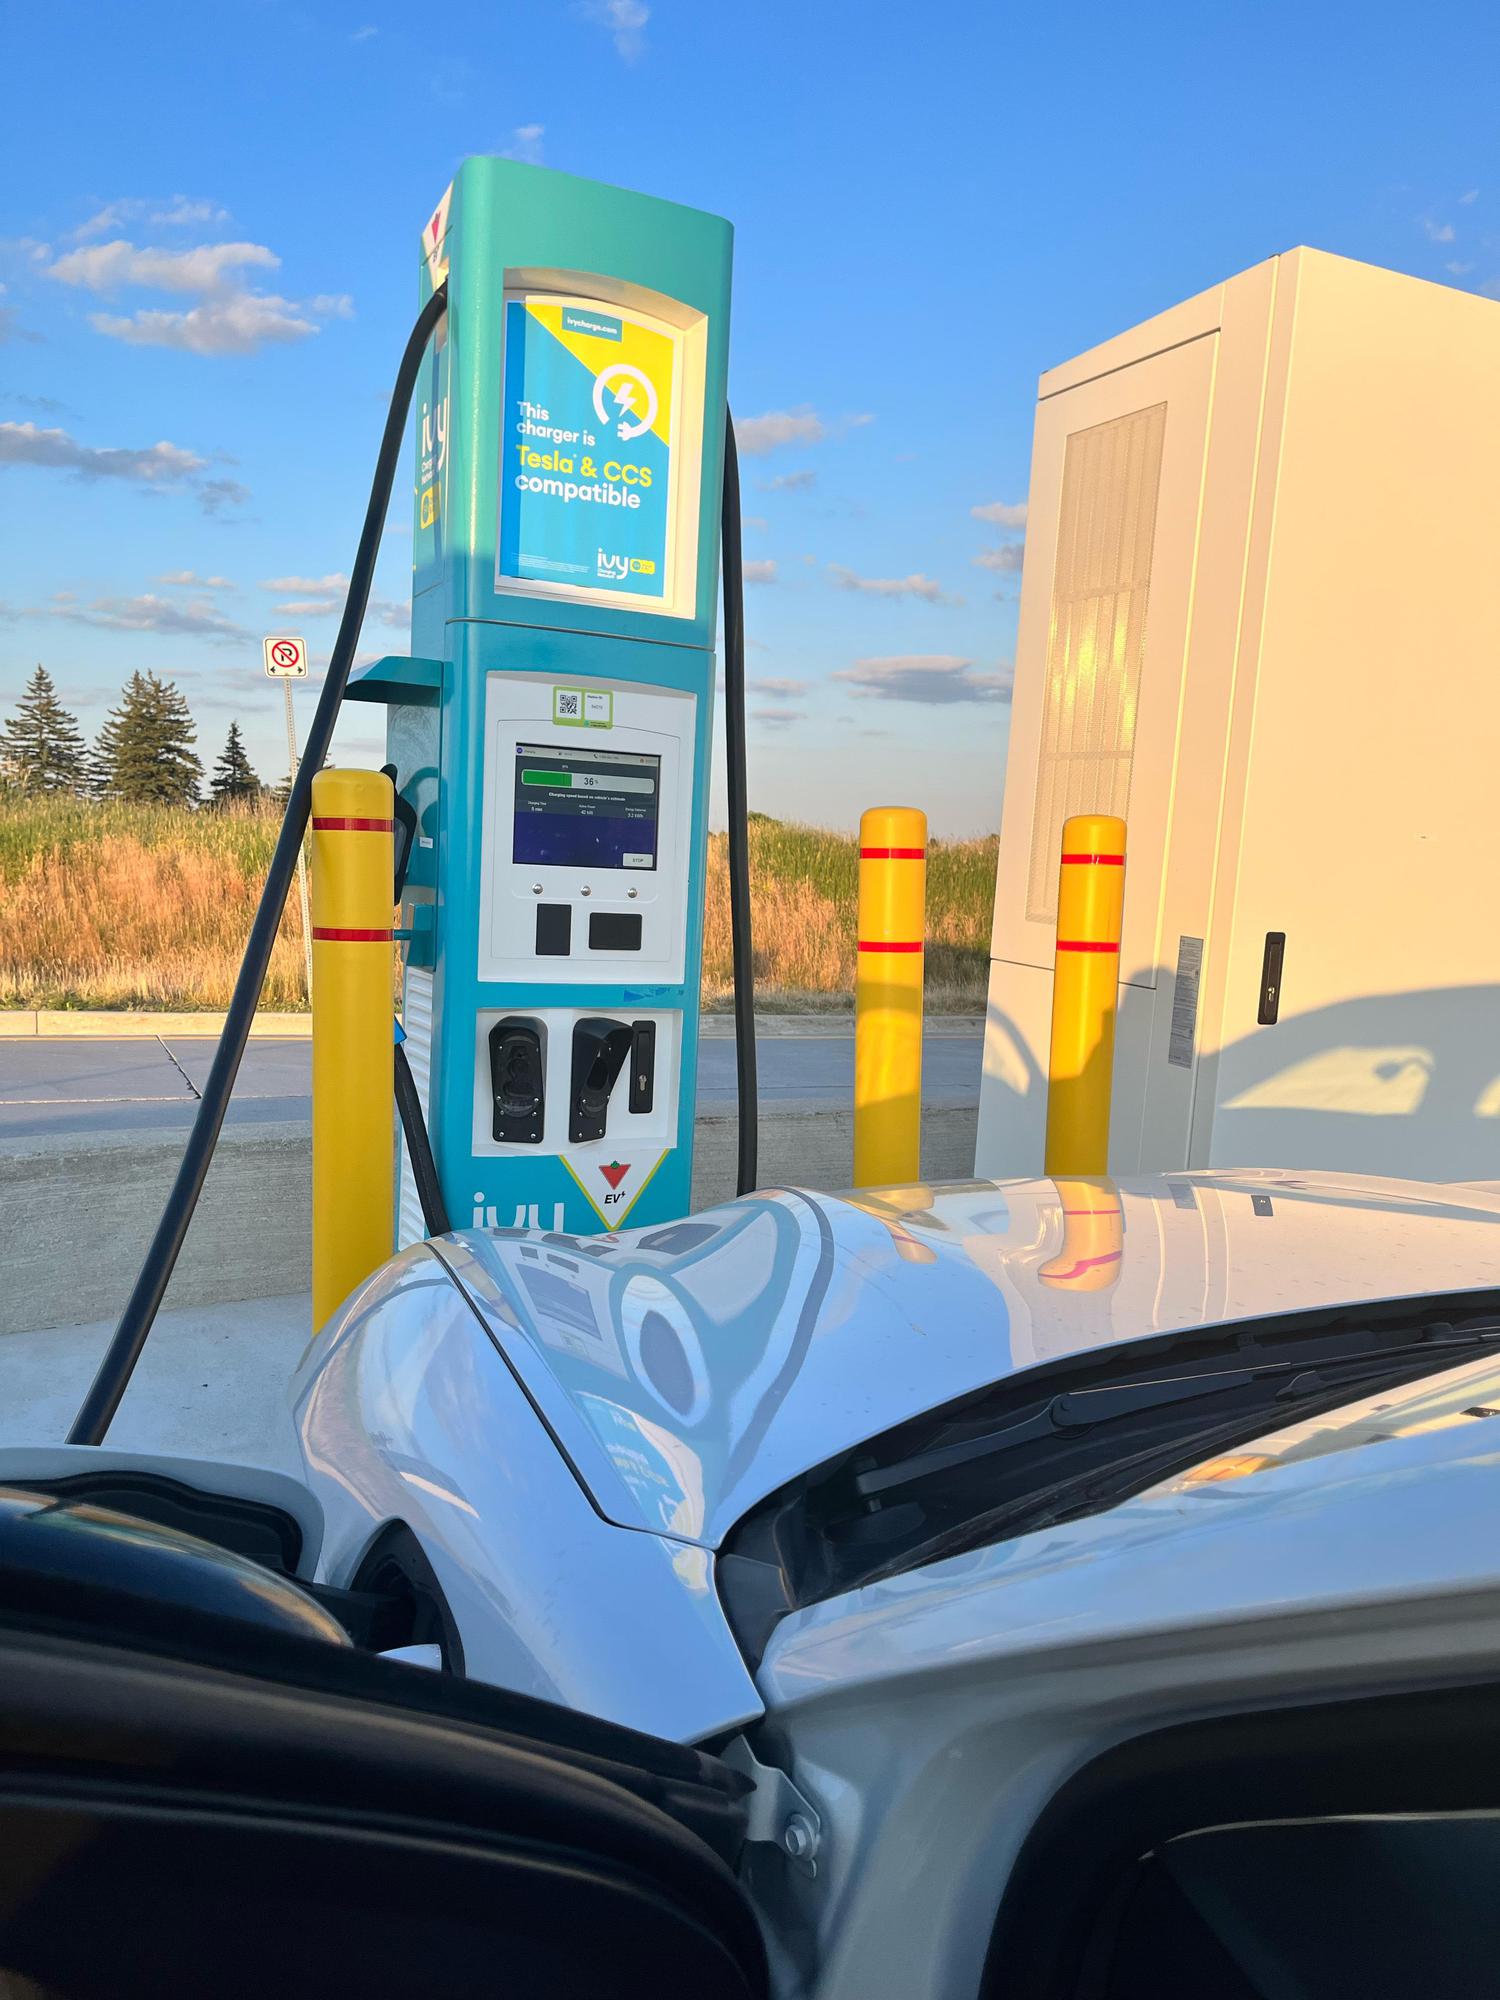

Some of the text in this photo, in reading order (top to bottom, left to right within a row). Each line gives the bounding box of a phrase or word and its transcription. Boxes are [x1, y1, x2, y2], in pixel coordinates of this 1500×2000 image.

[517, 401, 550, 421] This
[422, 397, 447, 471] ivy
[516, 419, 596, 446] charger is
[580, 456, 598, 478] &
[603, 460, 653, 488] CCS
[515, 474, 641, 509] compatible
[597, 547, 629, 580] ivy
[604, 1194, 621, 1204] EV
